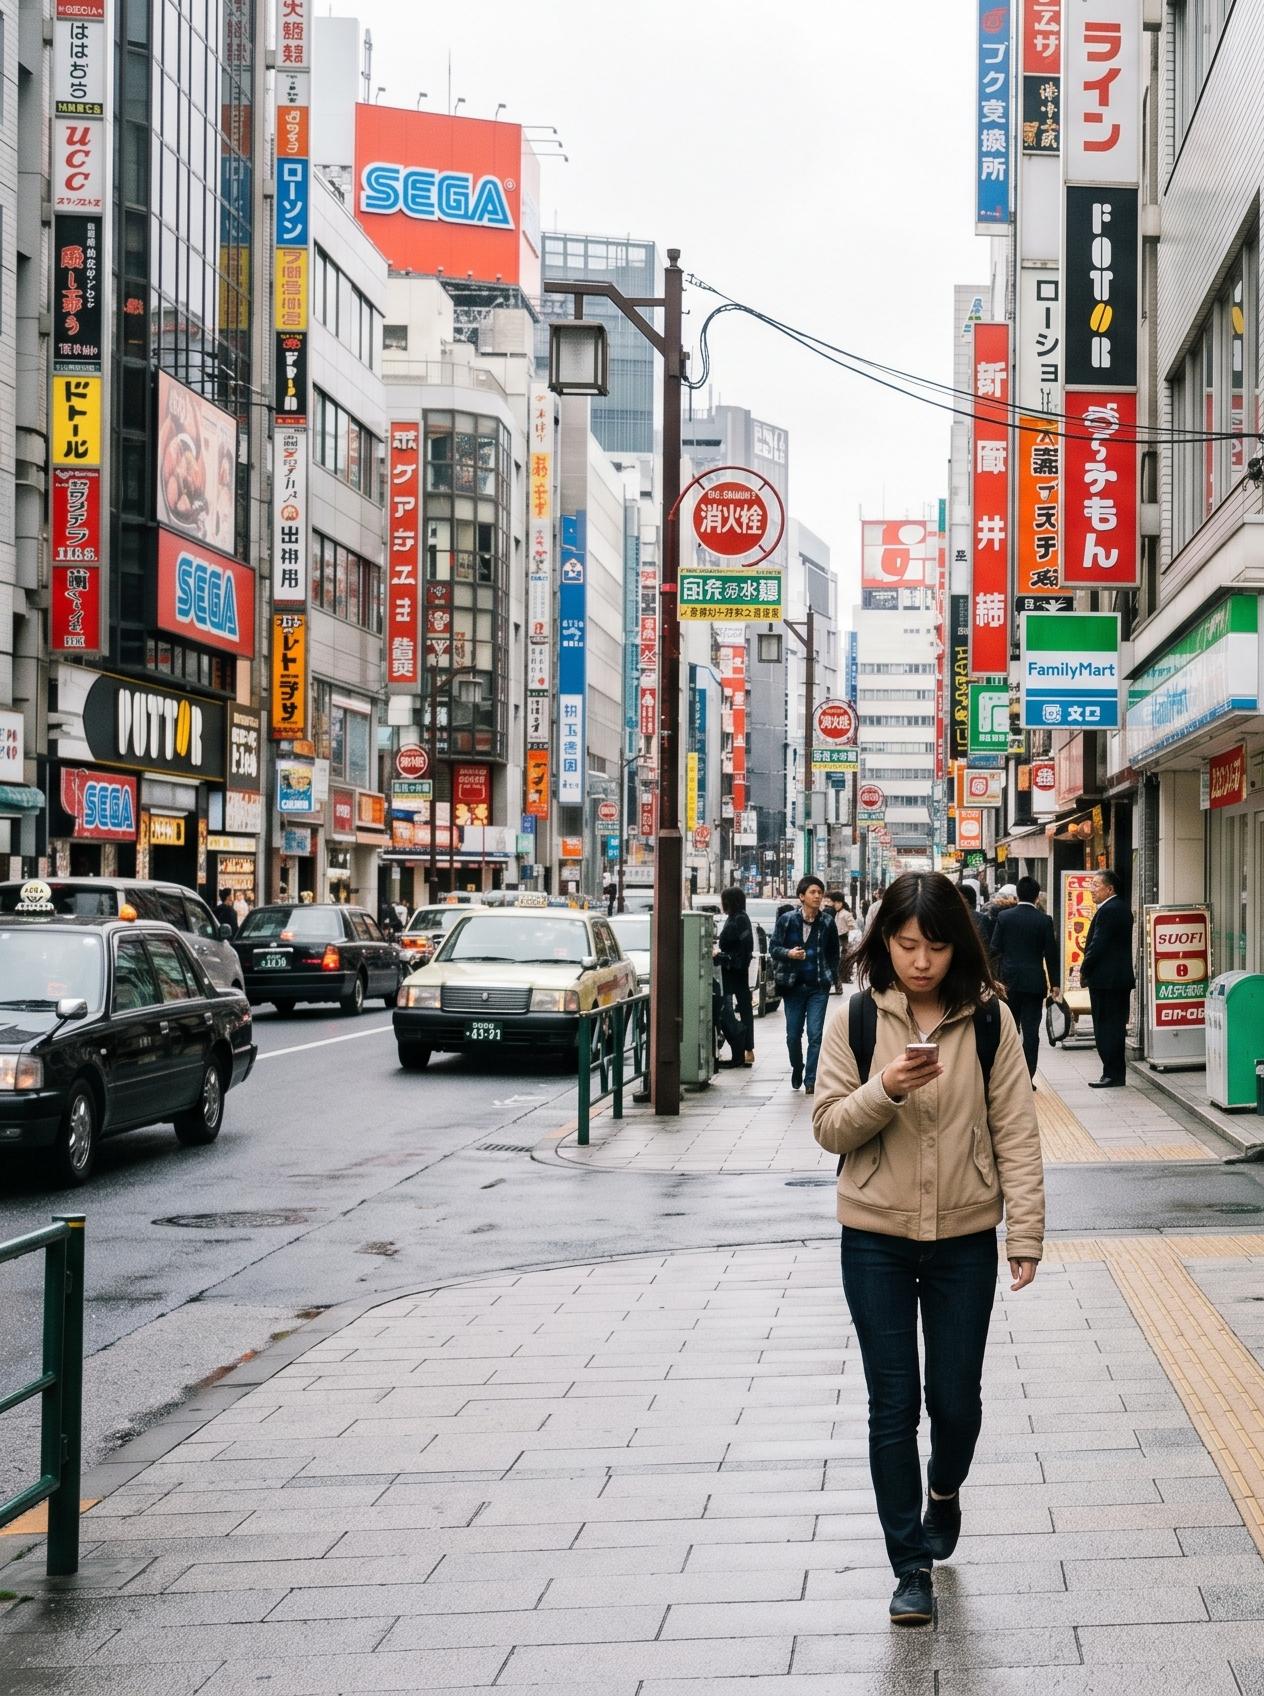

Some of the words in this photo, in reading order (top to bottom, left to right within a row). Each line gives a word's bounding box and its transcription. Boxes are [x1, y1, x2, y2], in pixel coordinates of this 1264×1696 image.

[1083, 22, 1122, 152] ライン
[282, 163, 302, 239] ローソン
[360, 162, 516, 231] SEGA
[64, 381, 89, 459] ドトール
[700, 502, 763, 535] 消火栓
[176, 552, 239, 642] SEGA
[1028, 662, 1115, 680] FamilyMart
[82, 780, 135, 832] SEGA
